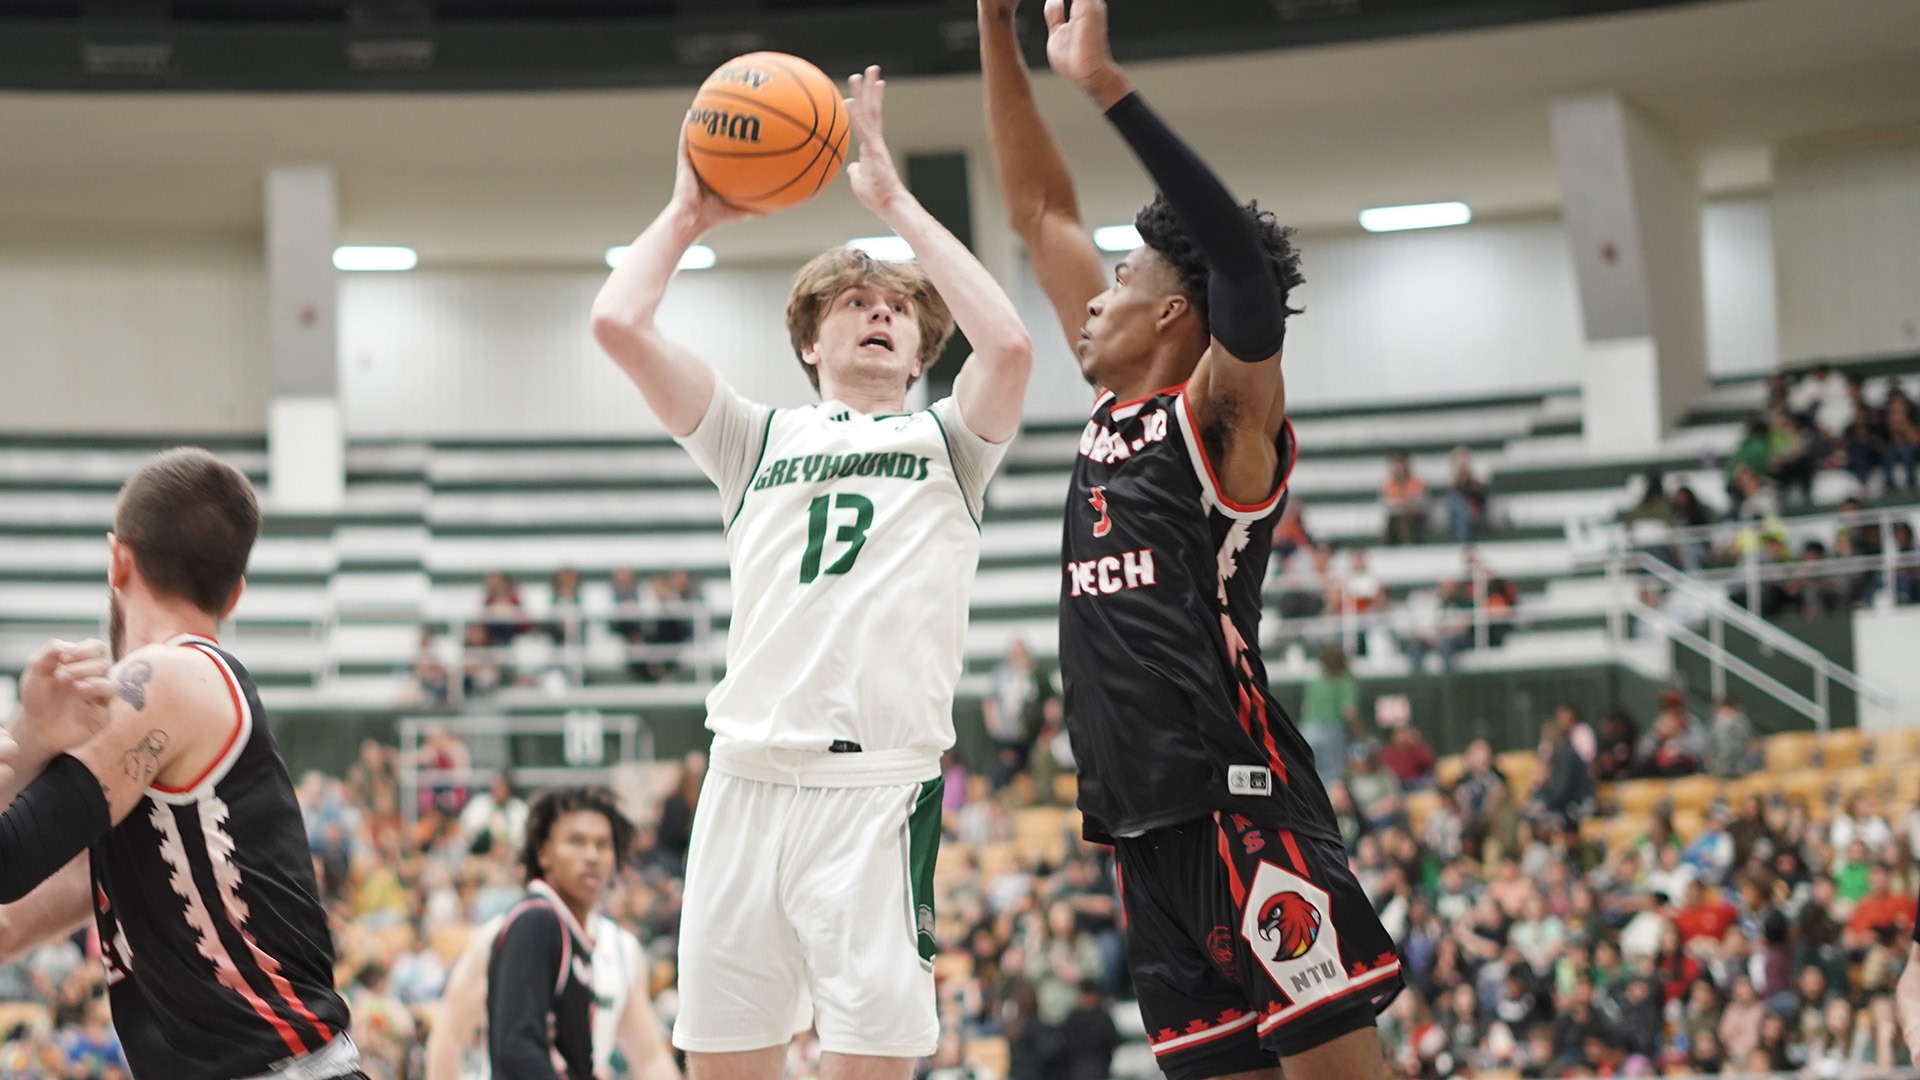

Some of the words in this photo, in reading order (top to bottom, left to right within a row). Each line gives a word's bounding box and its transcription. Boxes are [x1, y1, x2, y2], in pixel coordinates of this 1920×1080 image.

[690, 109, 761, 144] Wilso
[753, 452, 933, 491] GREYHOUNDS
[799, 493, 874, 584] 13
[1290, 959, 1337, 993] NTU
